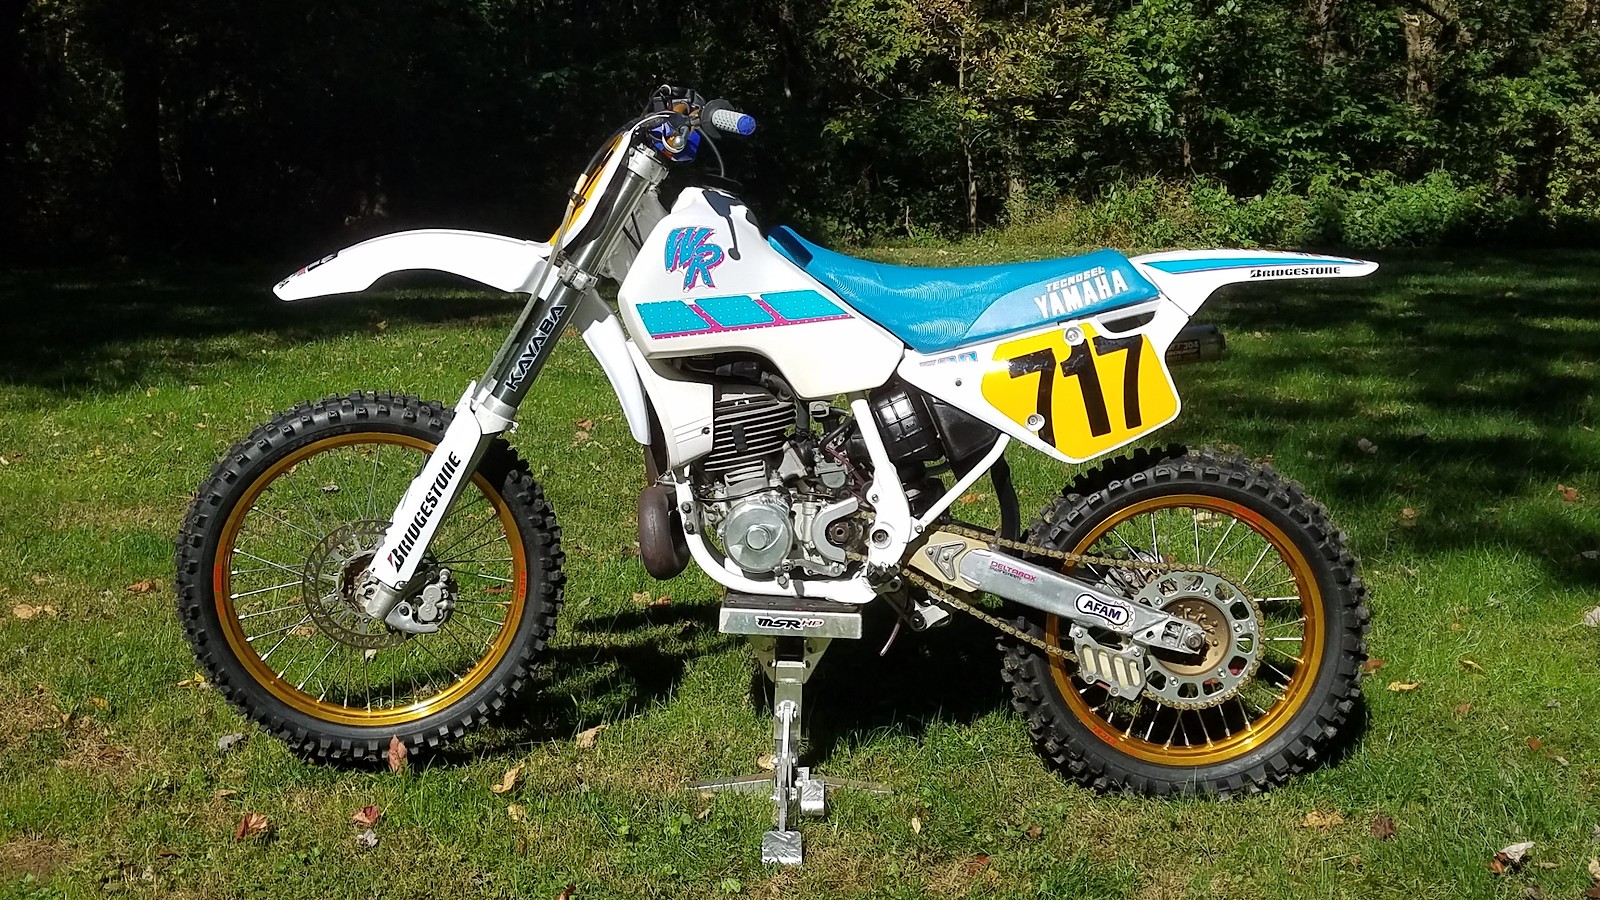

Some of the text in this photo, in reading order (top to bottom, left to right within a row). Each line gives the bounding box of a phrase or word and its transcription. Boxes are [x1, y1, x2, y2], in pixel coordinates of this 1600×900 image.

[665, 226, 725, 293] WR
[1250, 266, 1341, 279] BRIDGESTONE
[1033, 269, 1129, 319] YAMAHA
[504, 304, 567, 392] KAYABA
[1008, 333, 1143, 448] 717
[387, 451, 461, 573] BRIDGESTONE
[990, 560, 1037, 582] DELTABOX
[1083, 599, 1122, 621] AFAM
